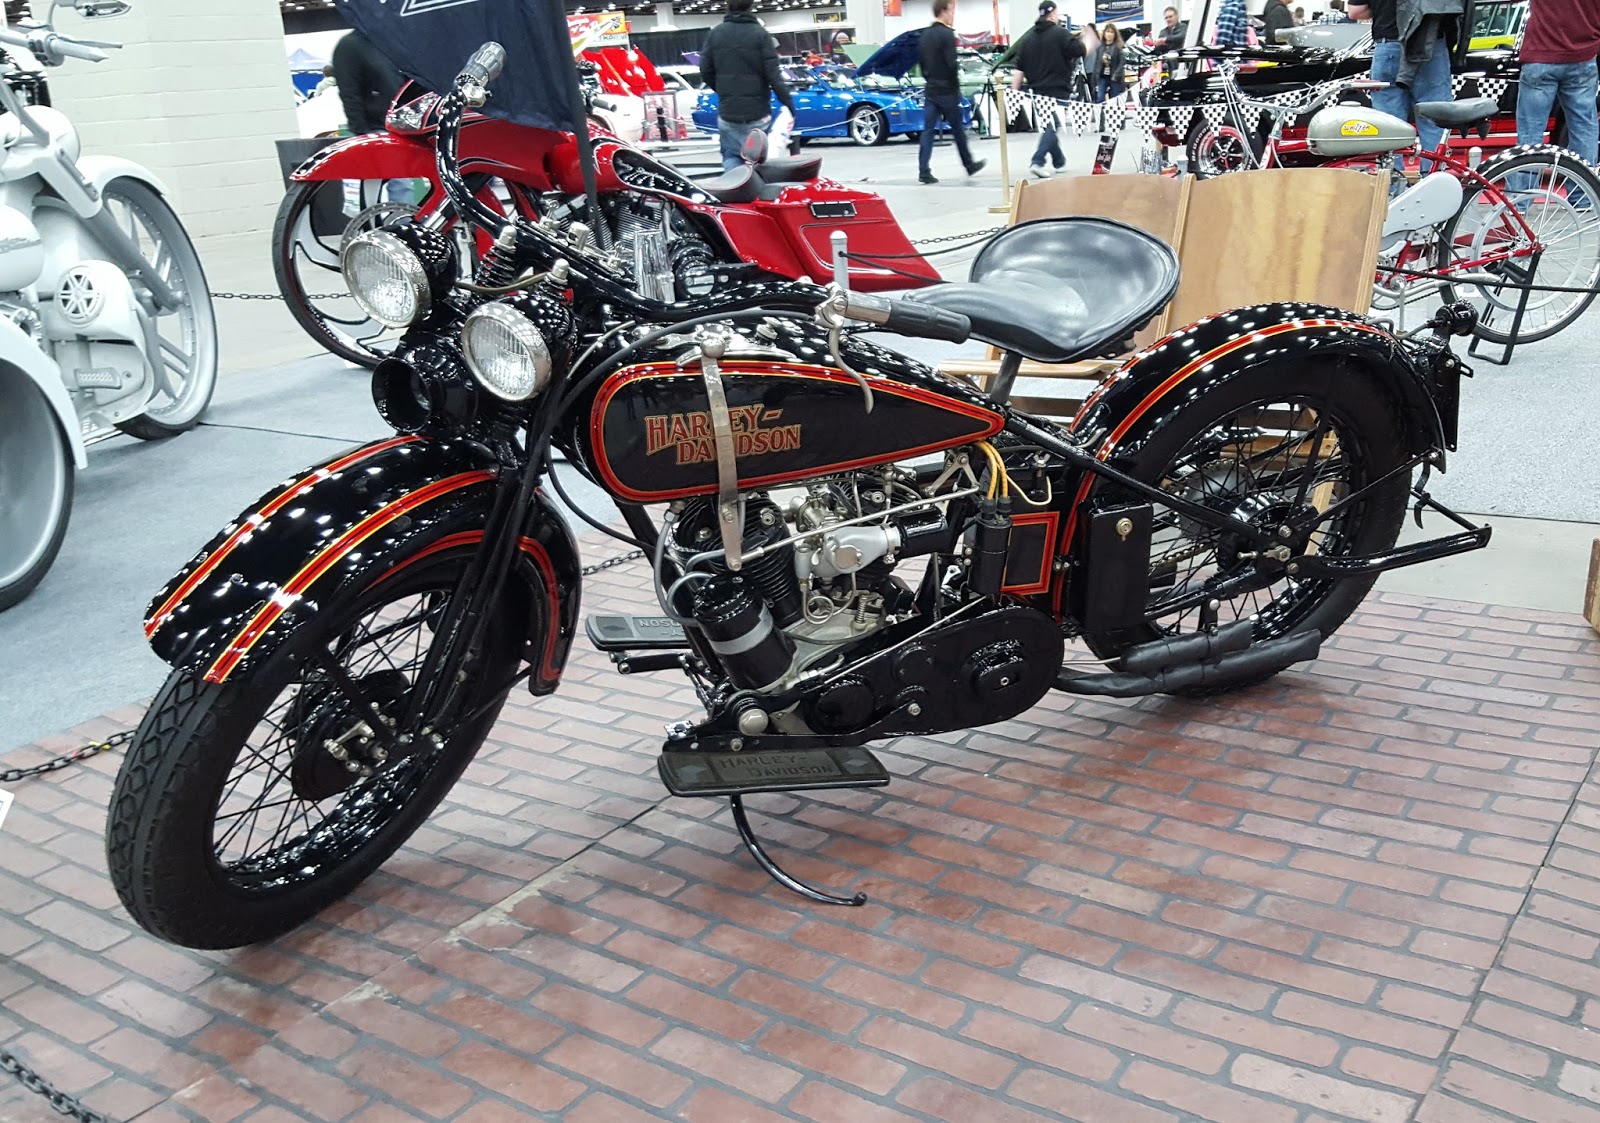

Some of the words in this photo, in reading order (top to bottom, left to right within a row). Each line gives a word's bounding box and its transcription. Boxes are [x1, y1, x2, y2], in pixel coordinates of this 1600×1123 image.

[676, 424, 802, 465] DADSON
[720, 754, 807, 769] HARLEY-
[748, 765, 834, 778] DAVIDSON
